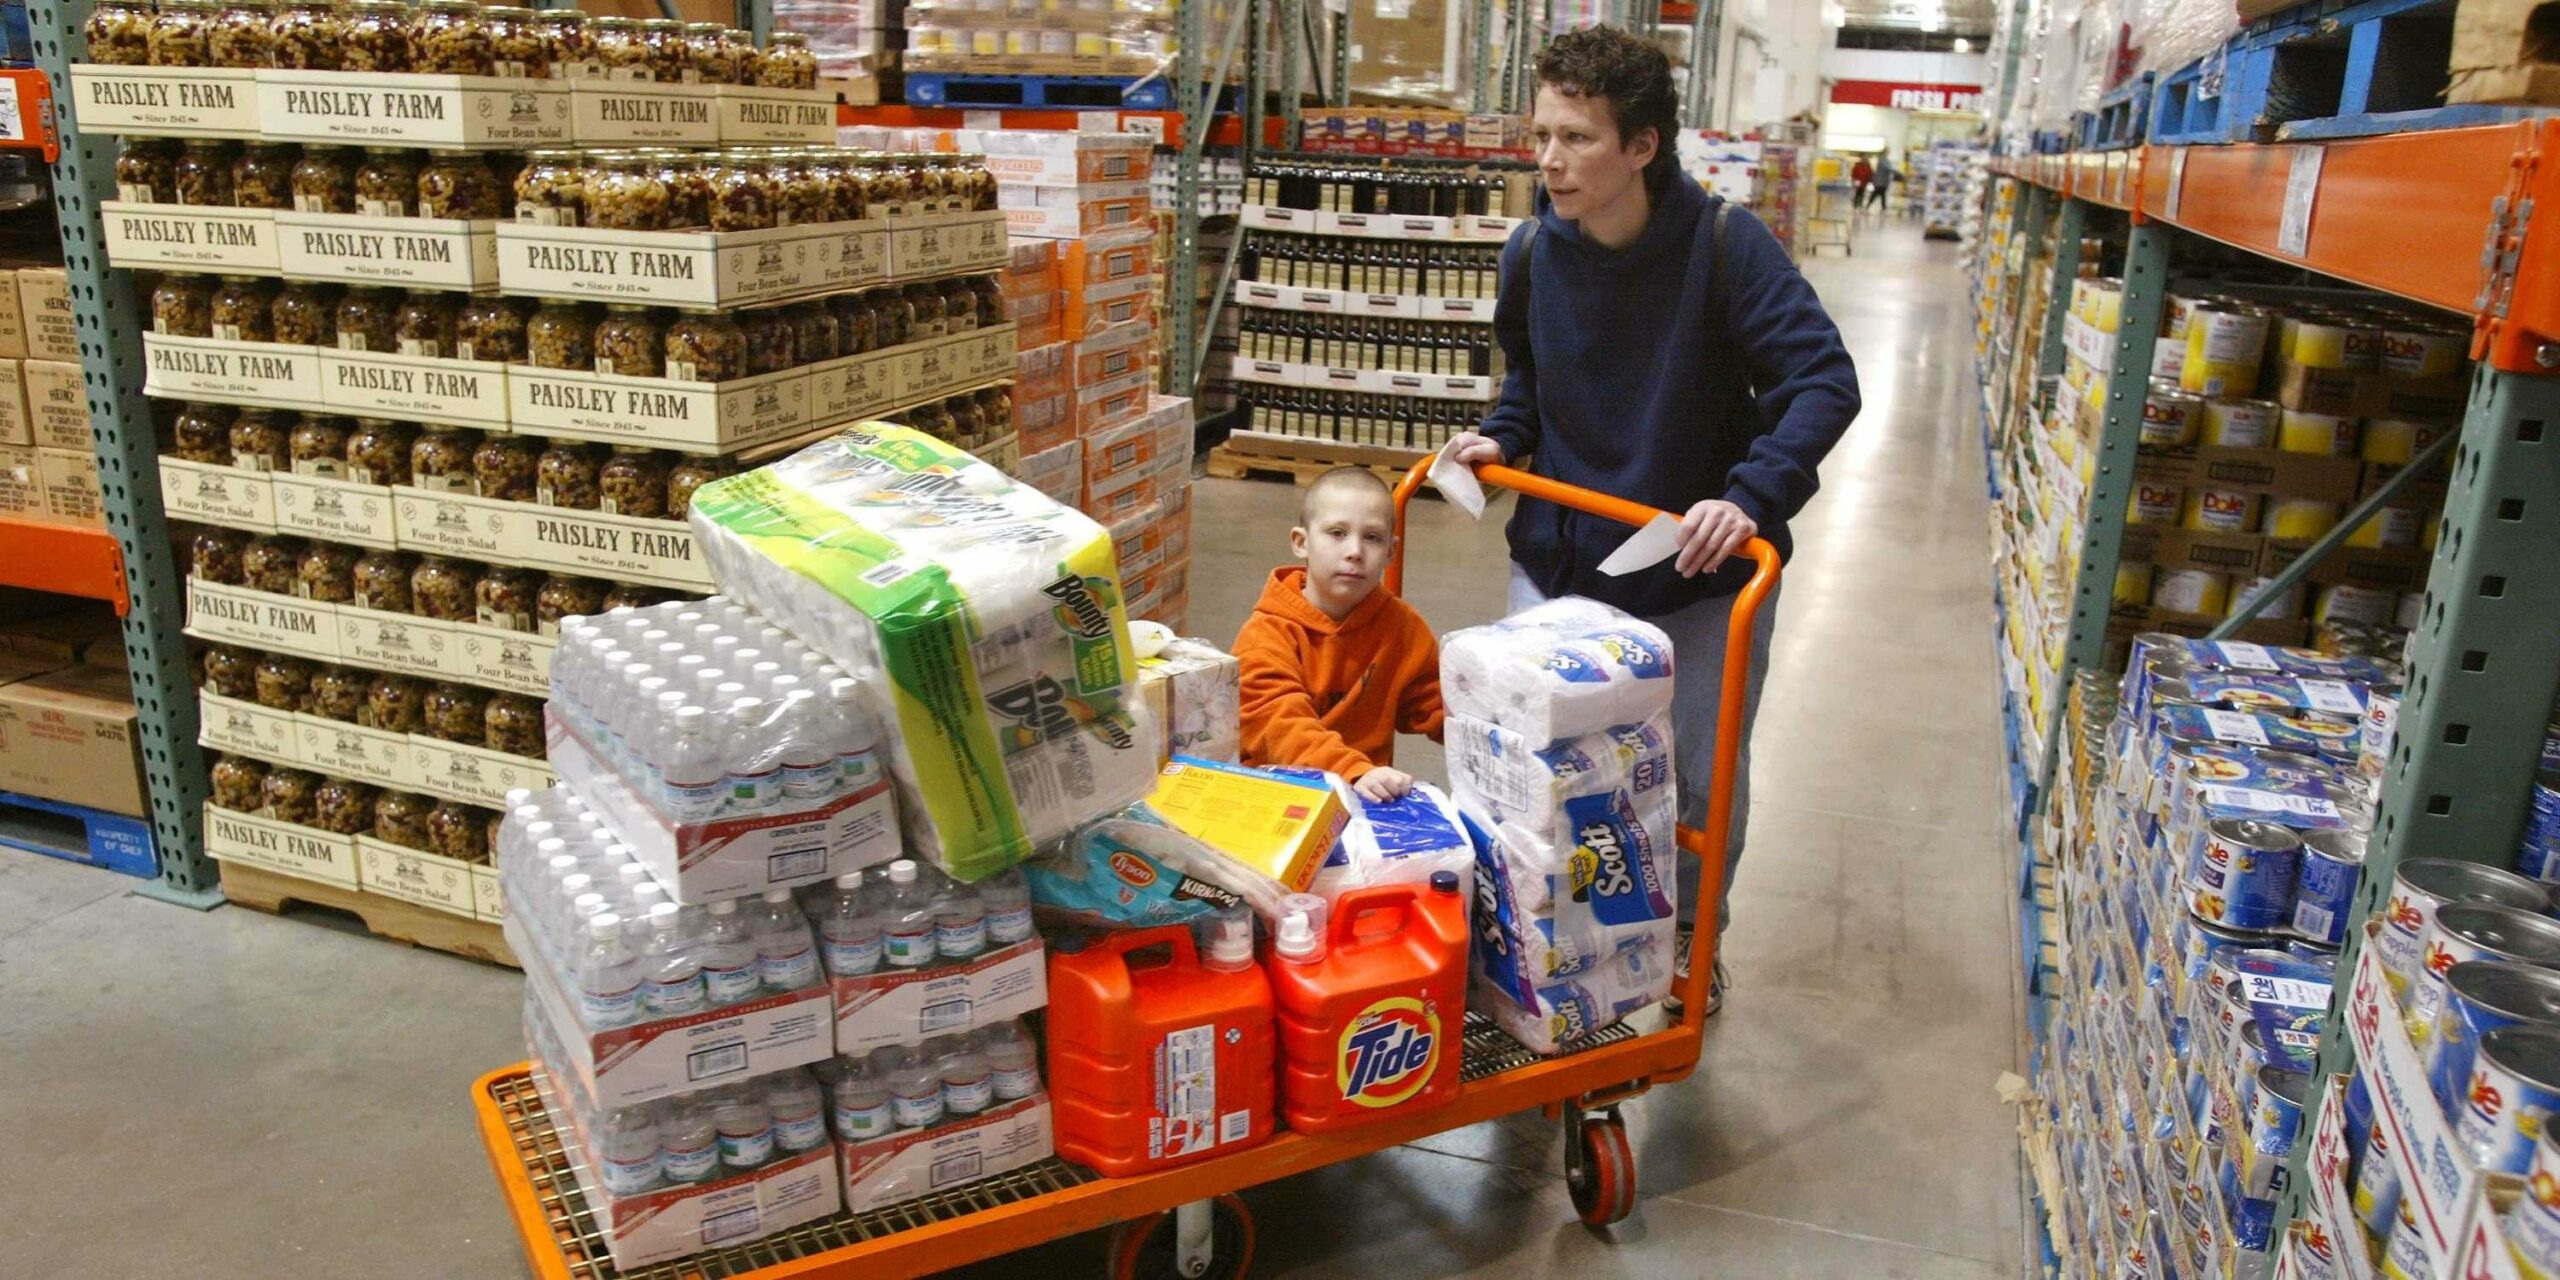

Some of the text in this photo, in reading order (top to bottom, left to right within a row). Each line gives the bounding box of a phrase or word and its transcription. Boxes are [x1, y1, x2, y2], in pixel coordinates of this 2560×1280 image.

[92, 82, 235, 110] PAISLEY FARM
[287, 91, 445, 120] PAISLEY FARM
[1891, 88, 1944, 109] FRESH
[601, 99, 708, 123] PAISLEY FARM
[740, 103, 827, 126] PAISLEY FARM
[487, 126, 562, 138] Four Bean Salad
[123, 219, 257, 247] PAISLEY FARM
[303, 231, 451, 263] PAISLEY FARM
[528, 246, 694, 280] PAISLEY FARM
[825, 262, 879, 280] Four Bean Salad
[586, 282, 611, 293] Since
[738, 273, 800, 293] Four Bean Salad
[43, 297, 71, 312] HEINZ
[2383, 335, 2424, 354] Dole
[153, 349, 294, 381] PAISLEY FARM
[49, 387, 75, 403] HEINZ
[339, 366, 480, 400] PAISLEY FARM
[530, 383, 689, 420] PAISLEY FARM
[828, 391, 881, 412] Four Bean Salad
[2144, 399, 2185, 420] Dole
[586, 418, 611, 429] Since
[734, 414, 798, 436] Four Bean Salad
[177, 496, 254, 520] Four Bean Salad
[2139, 486, 2177, 508] Dole
[2204, 492, 2245, 511] Dole
[292, 513, 371, 535] Four Bean Salad
[413, 528, 497, 551] Four Bean Salad
[537, 520, 690, 561] PAISLEY FARM
[195, 594, 317, 635] PAISLEY FARM
[1041, 573, 1112, 640] Bounty
[356, 645, 439, 669] Four Bean Salad
[477, 664, 550, 687] Four Bean Sal
[208, 729, 279, 755] Four Bean Salad
[315, 752, 391, 777] Four Bean Salad
[1184, 767, 1215, 781] Bacon
[1635, 759, 1653, 793] 20
[426, 774, 449, 788] Four
[450, 779, 477, 793] Bean
[215, 819, 333, 863] PAISLEY FARM
[769, 823, 826, 838] CRYSTAL GEYSER
[1582, 820, 1634, 898] Scott
[1629, 820, 1659, 894] 1000 Sheets
[2205, 841, 2229, 861] ole
[1115, 855, 1152, 881] Tyson
[375, 873, 451, 903] Four Bean Salad
[2389, 896, 2423, 931] ole
[687, 1018, 744, 1037] CRYSTAL GEYSER
[1557, 998, 1584, 1042] Scott
[1342, 1019, 1433, 1100] Tide
[2468, 1071, 2503, 1116] ole
[931, 1130, 981, 1150] CRYSTAL GEYSER
[702, 1192, 728, 1205] CRYSTAL
